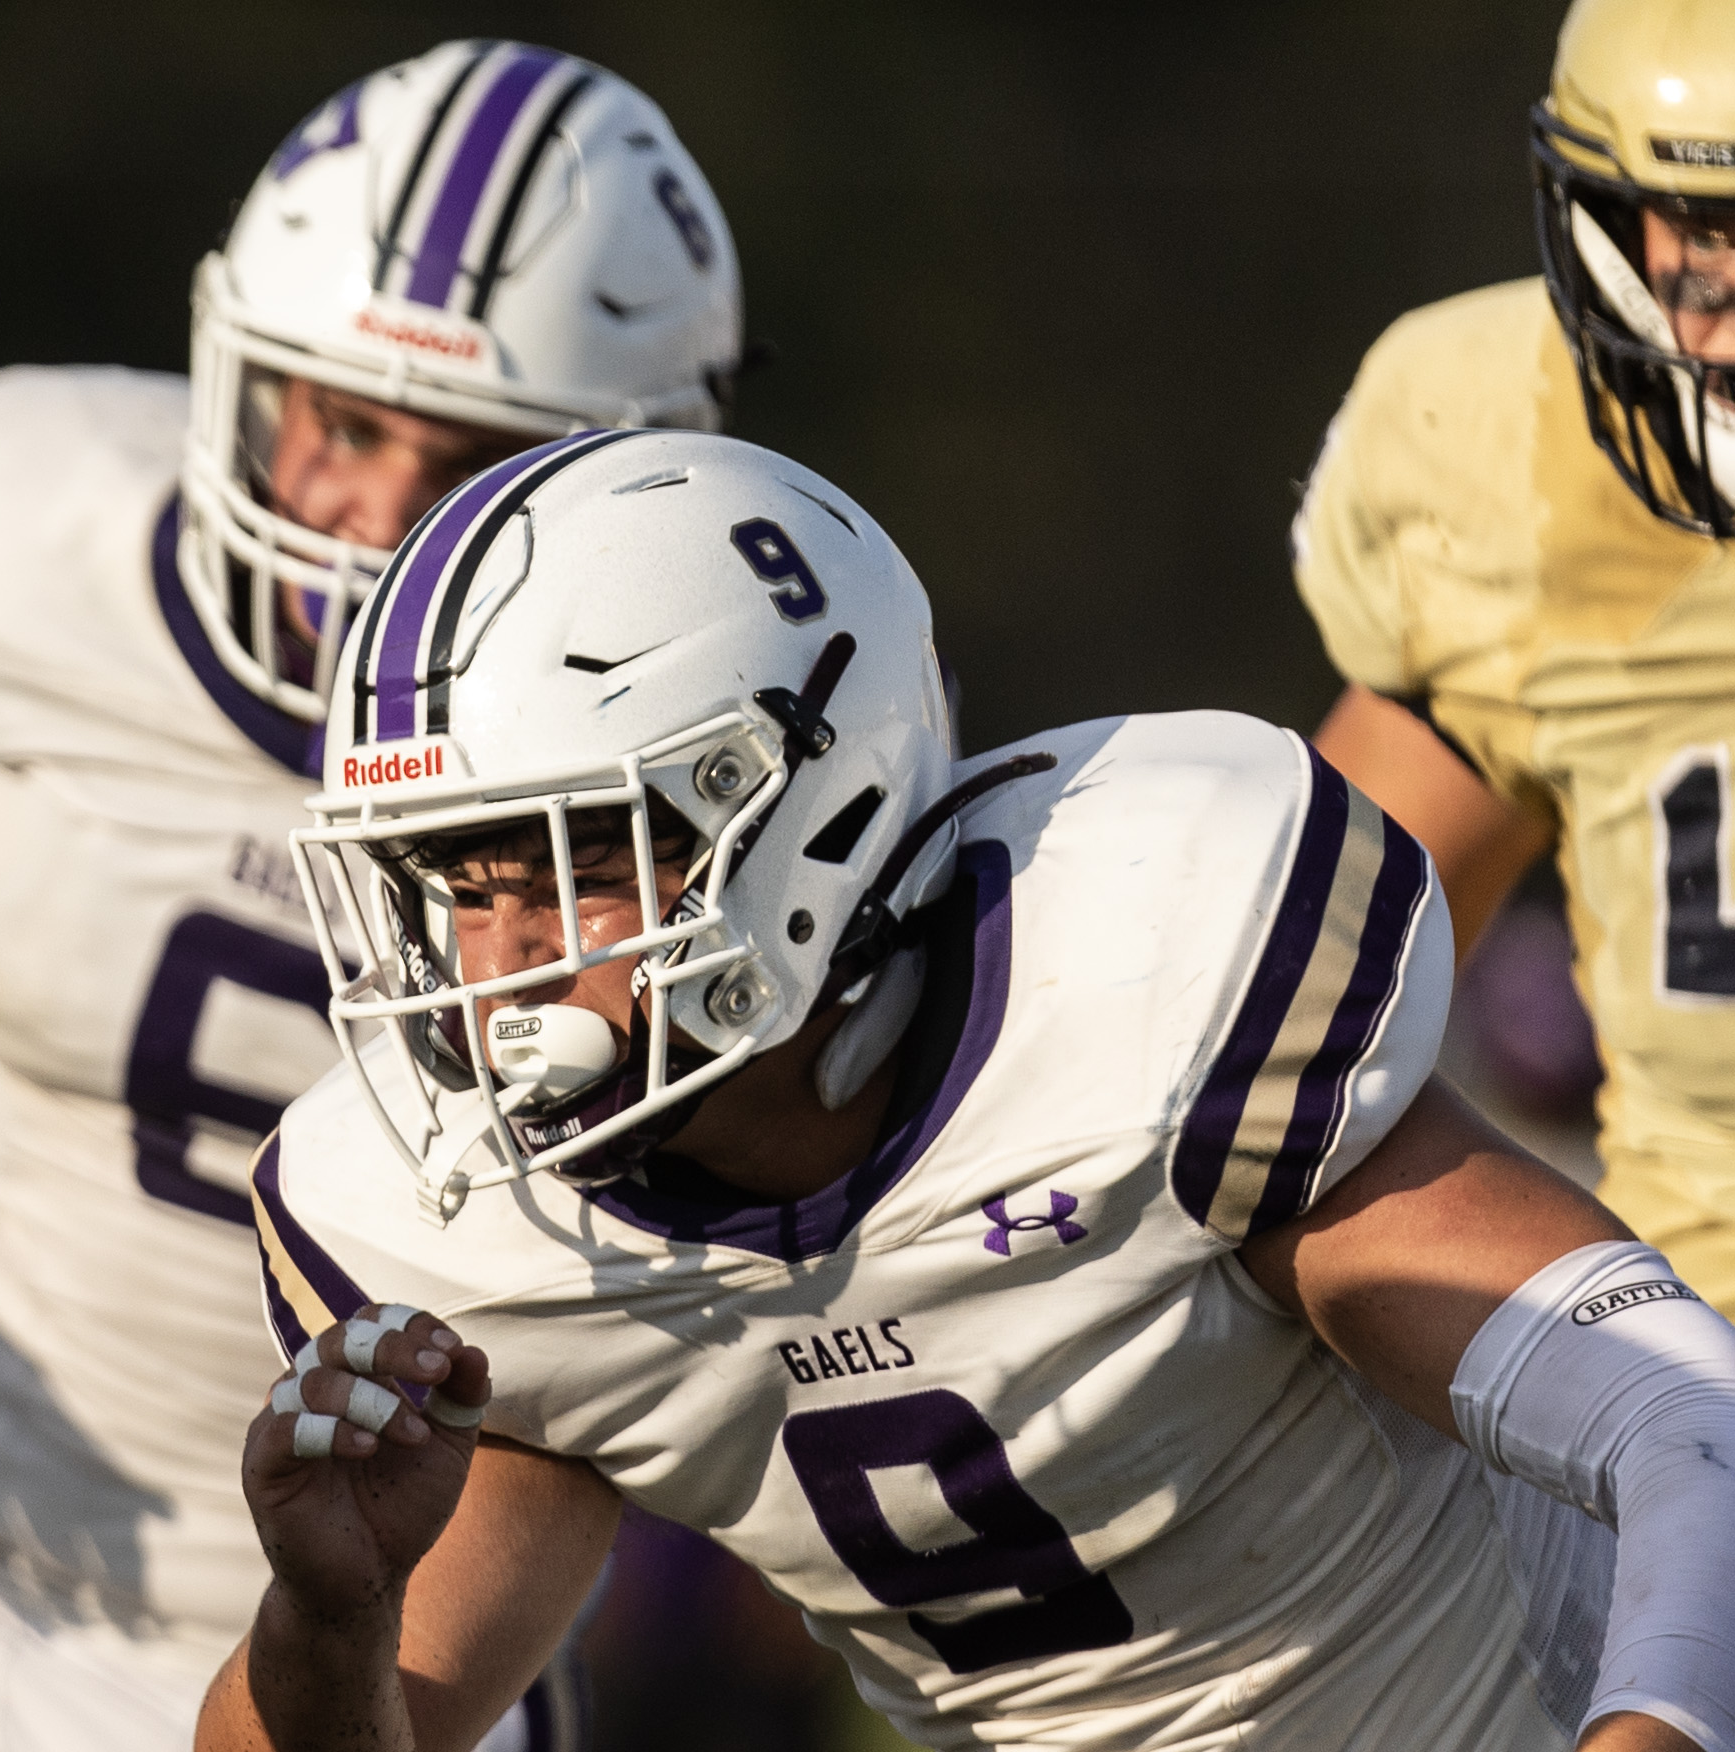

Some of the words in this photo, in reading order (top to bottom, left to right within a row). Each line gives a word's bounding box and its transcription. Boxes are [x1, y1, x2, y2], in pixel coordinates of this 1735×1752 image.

[730, 516, 830, 627] 9
[344, 745, 443, 788] Riddell
[778, 1317, 916, 1385] GAELS
[782, 1386, 1135, 1675] 9
